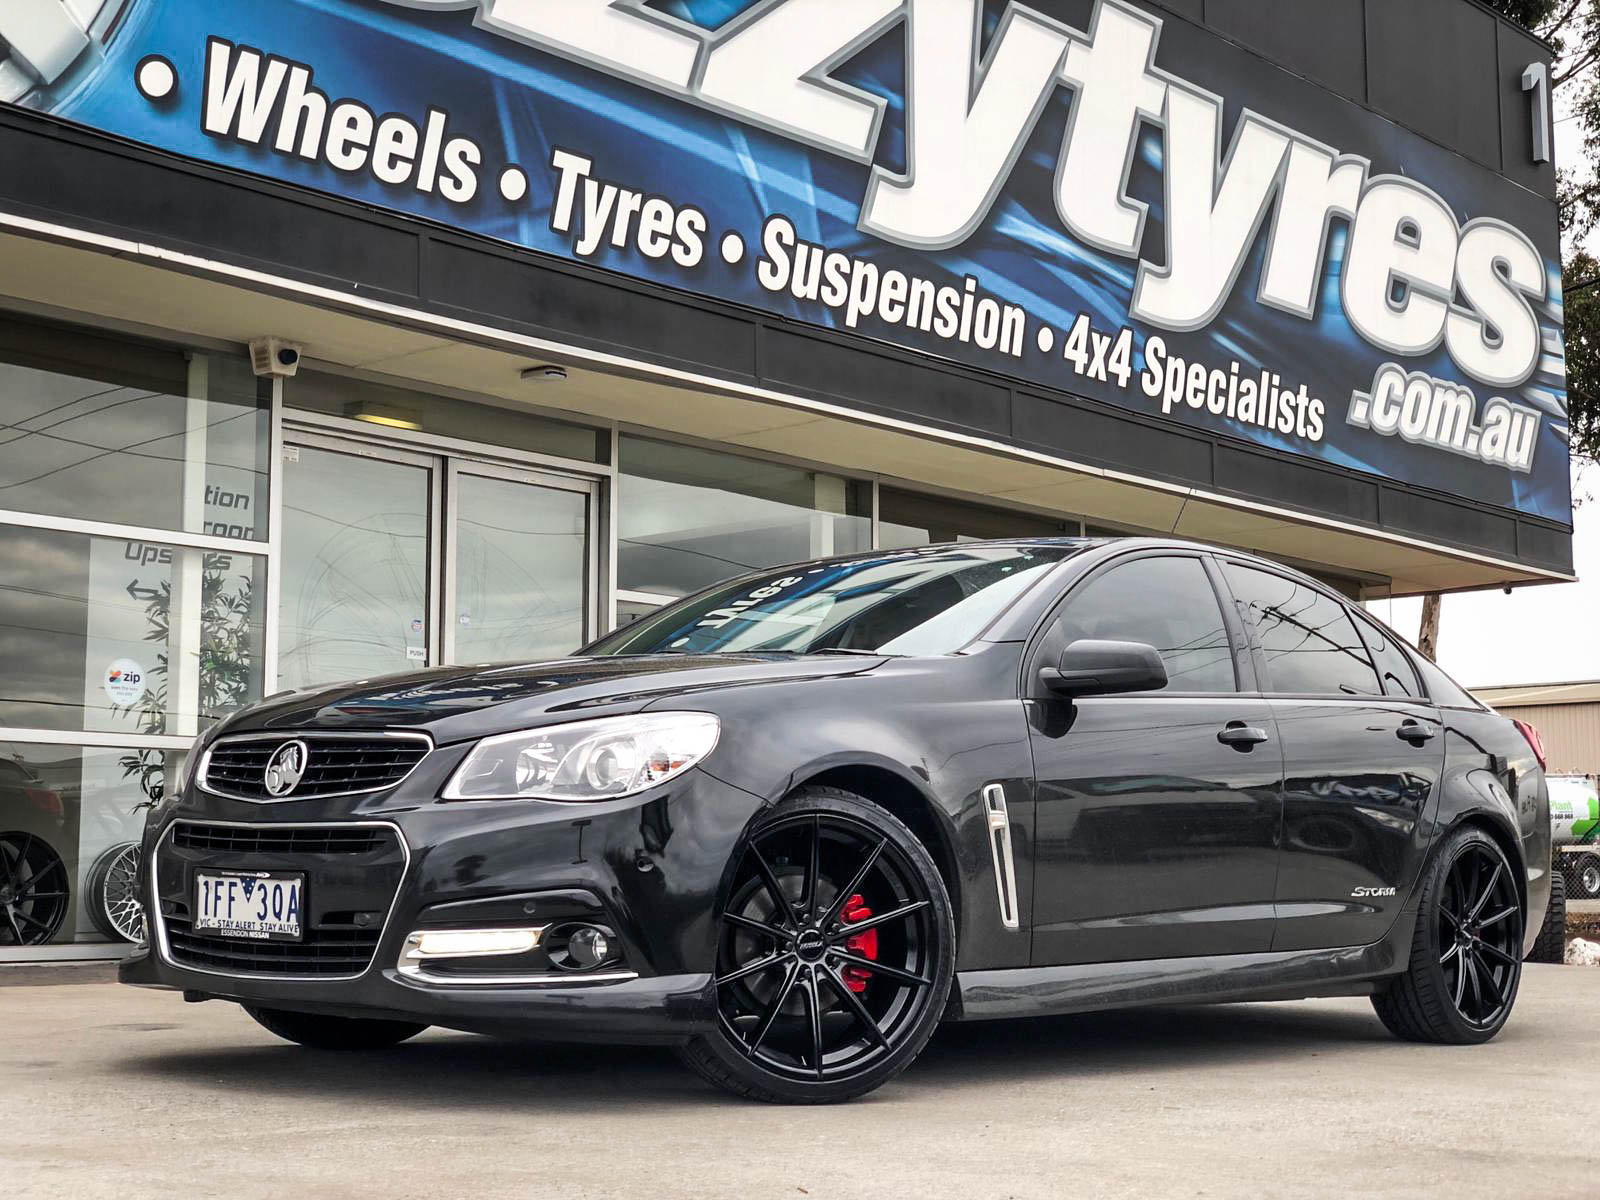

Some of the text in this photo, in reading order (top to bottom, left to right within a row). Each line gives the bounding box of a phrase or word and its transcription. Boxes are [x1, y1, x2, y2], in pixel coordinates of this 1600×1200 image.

[1522, 61, 1550, 164] 1
[204, 40, 1326, 443] Wheels Tyres Suspension 4x4 Specialists
[1347, 362, 1543, 472] .com.au
[123, 671, 141, 685] zip
[203, 880, 299, 922] 1FF 3QA
[200, 919, 299, 934] VIC STAY ALERT STAY ALIVE
[248, 931, 270, 939] NISSAN
